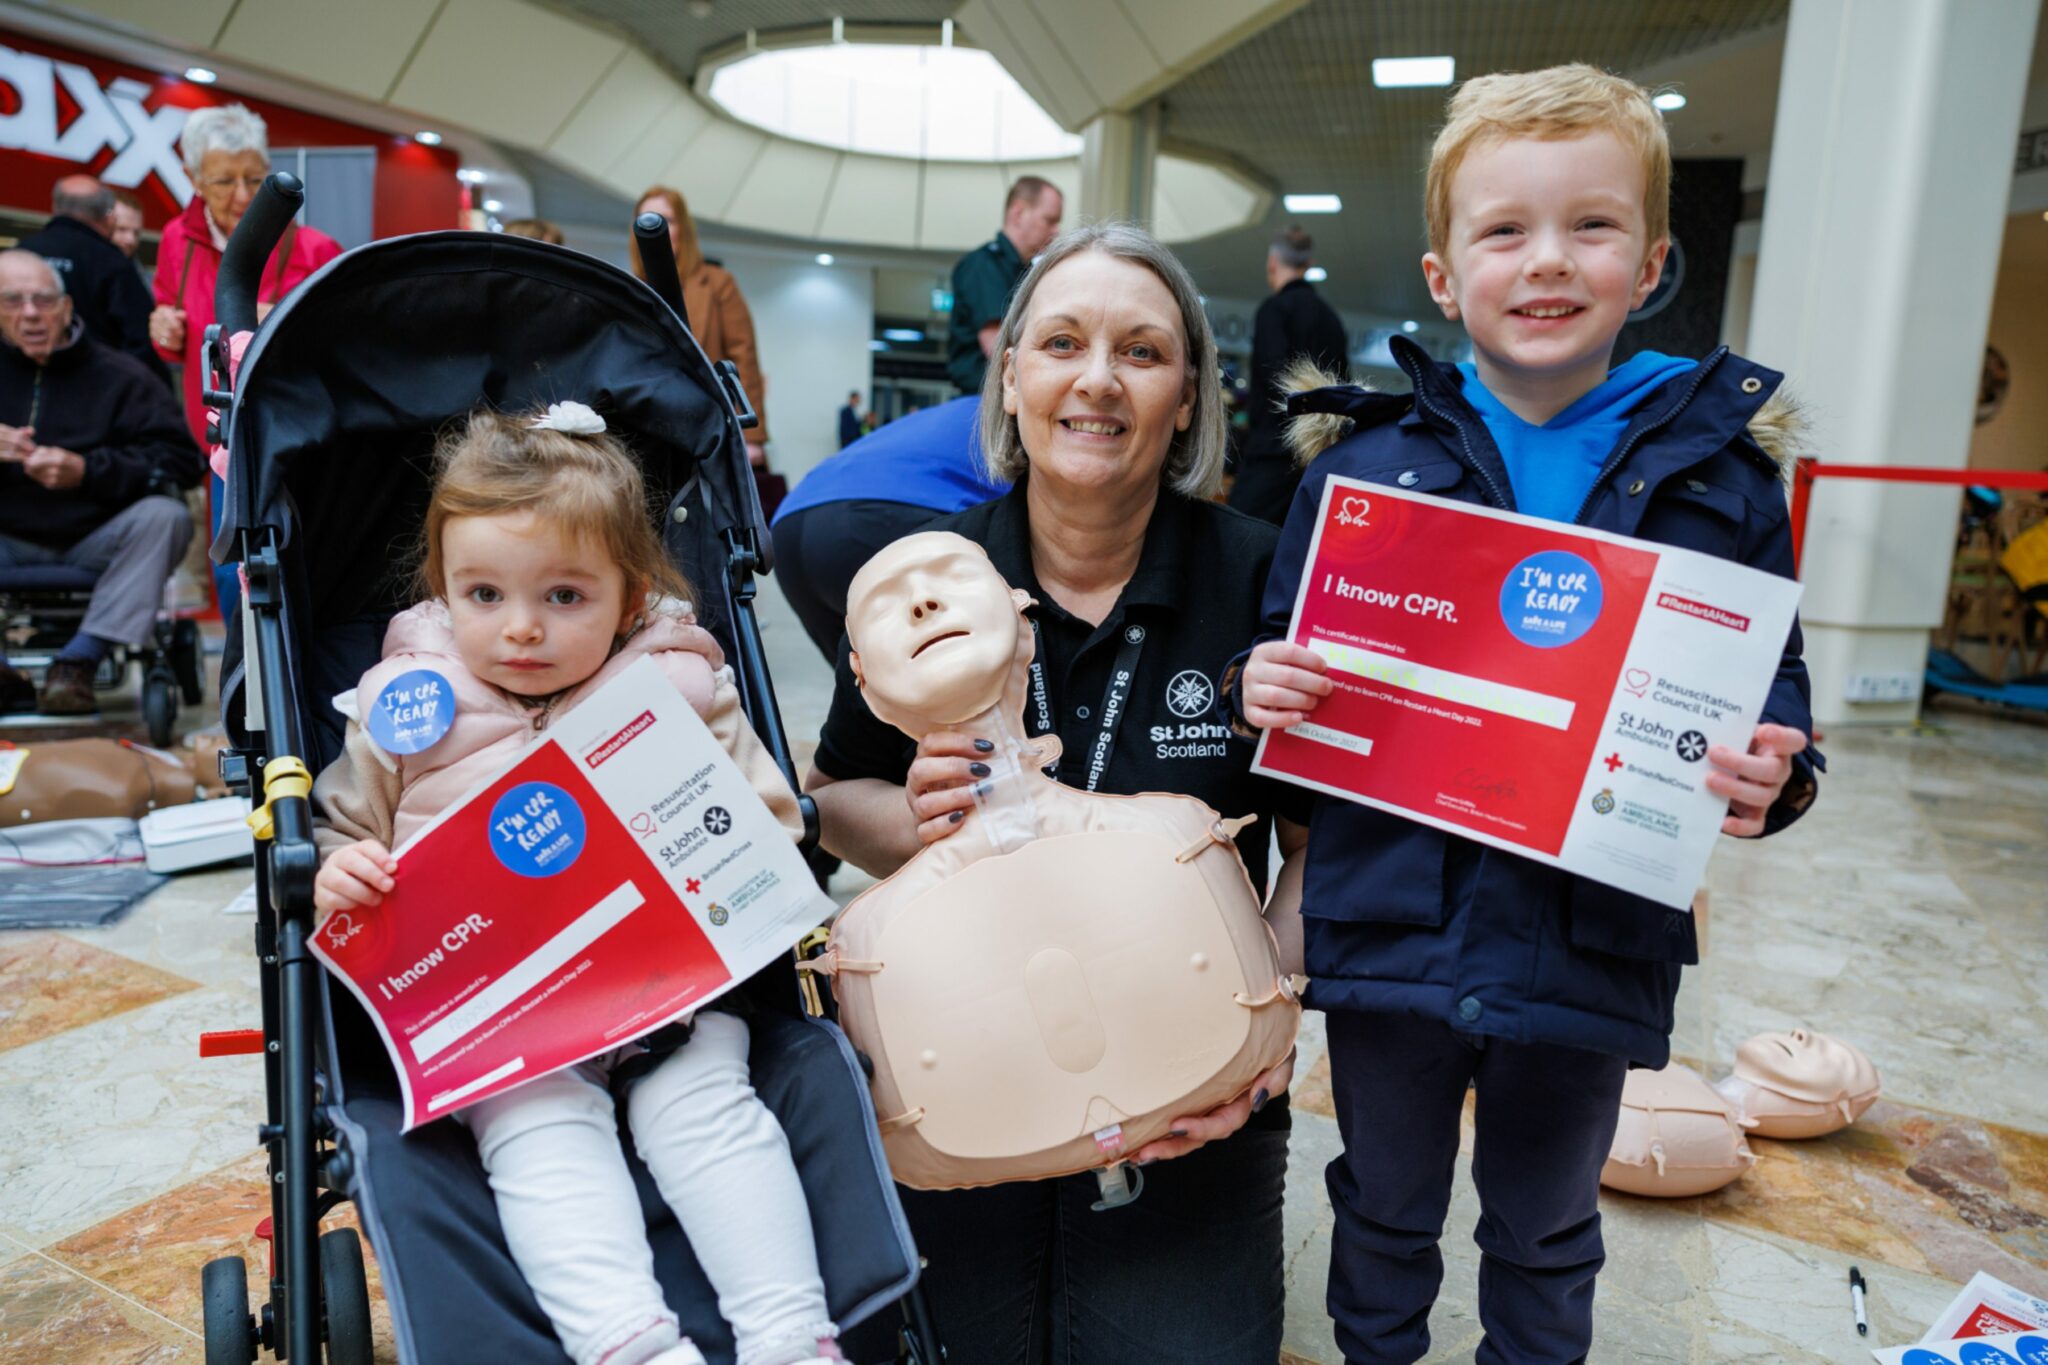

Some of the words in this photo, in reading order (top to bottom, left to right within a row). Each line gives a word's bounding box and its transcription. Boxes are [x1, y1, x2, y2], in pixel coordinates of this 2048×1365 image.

[1519, 567, 1552, 588] I'M
[1557, 573, 1588, 593] CPR
[1323, 573, 1333, 593] I
[1335, 576, 1400, 608] know
[1403, 593, 1458, 623] CPR.
[1525, 588, 1580, 613] READY
[1114, 670, 1130, 687] St
[384, 689, 411, 710] I'M
[415, 681, 441, 700] CPR
[1030, 662, 1050, 730] Scotland
[1102, 691, 1124, 728] John
[1379, 693, 1393, 702] CPR
[1652, 691, 1702, 715] Council
[1703, 707, 1723, 722] UK
[1657, 677, 1742, 713] Resuscitation
[394, 701, 438, 726] READY
[1618, 712, 1635, 729] St
[1637, 718, 1675, 740] John
[1150, 725, 1174, 742] St
[1176, 722, 1232, 740] John
[1615, 727, 1670, 750] Ambulance
[1087, 731, 1112, 792] Scotlan
[1156, 742, 1226, 759] Scotland
[650, 762, 716, 814] Resuscitation
[659, 793, 696, 824] Council
[695, 780, 712, 797] UK
[495, 813, 528, 842] I'M
[524, 791, 554, 817] CPR
[517, 809, 562, 851] READY
[660, 846, 676, 861] St
[674, 826, 704, 852] John
[669, 837, 709, 869] Ambulance
[378, 983, 393, 1001] I
[388, 948, 446, 993] know
[441, 913, 493, 952] CPR.
